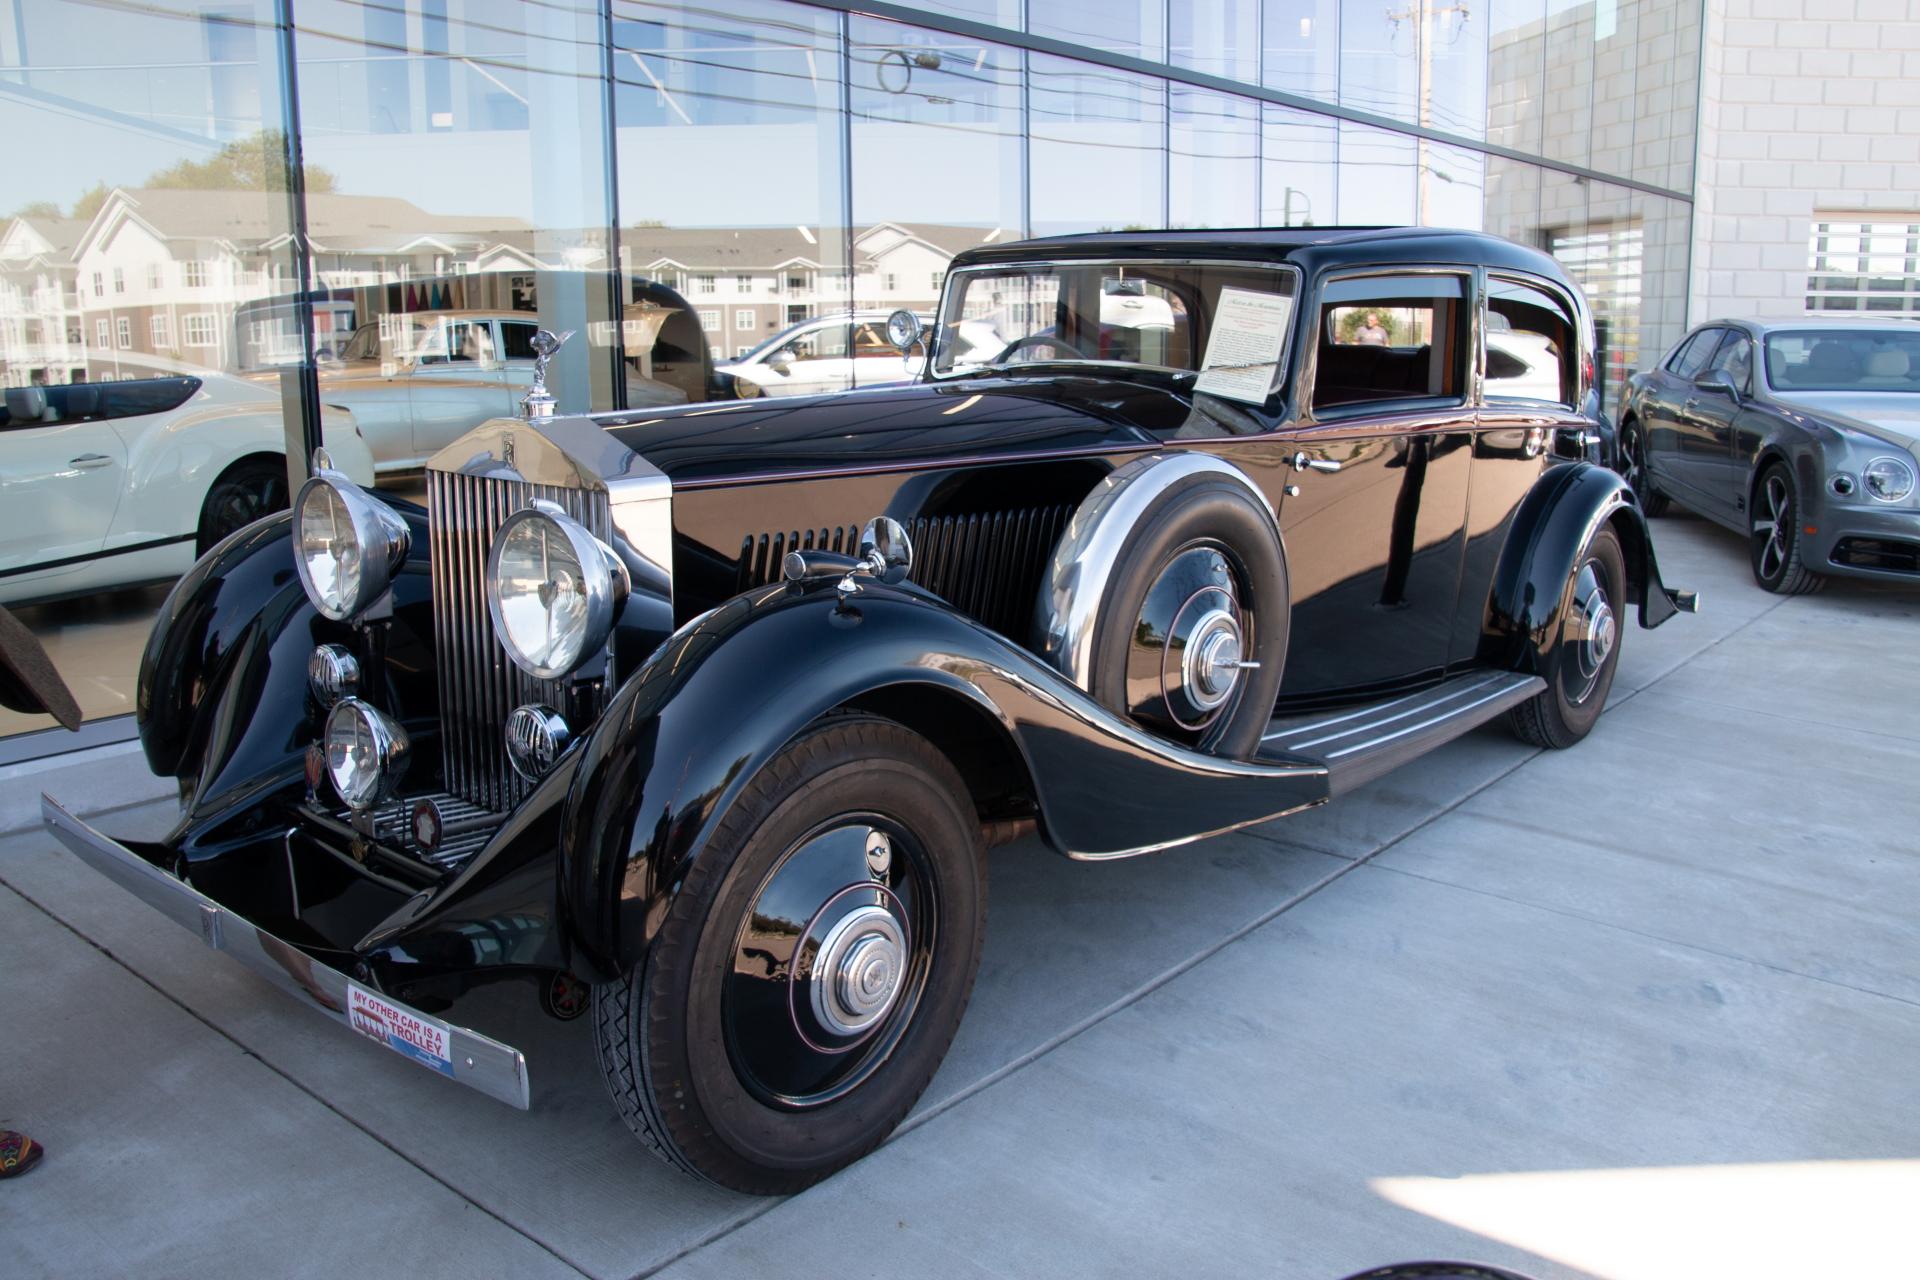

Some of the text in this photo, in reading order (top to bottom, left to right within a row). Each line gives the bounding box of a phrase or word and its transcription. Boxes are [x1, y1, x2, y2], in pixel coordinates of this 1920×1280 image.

[354, 991, 442, 1043] MY OTHER CAR IS A
[389, 1020, 444, 1057] TROLLEY.
